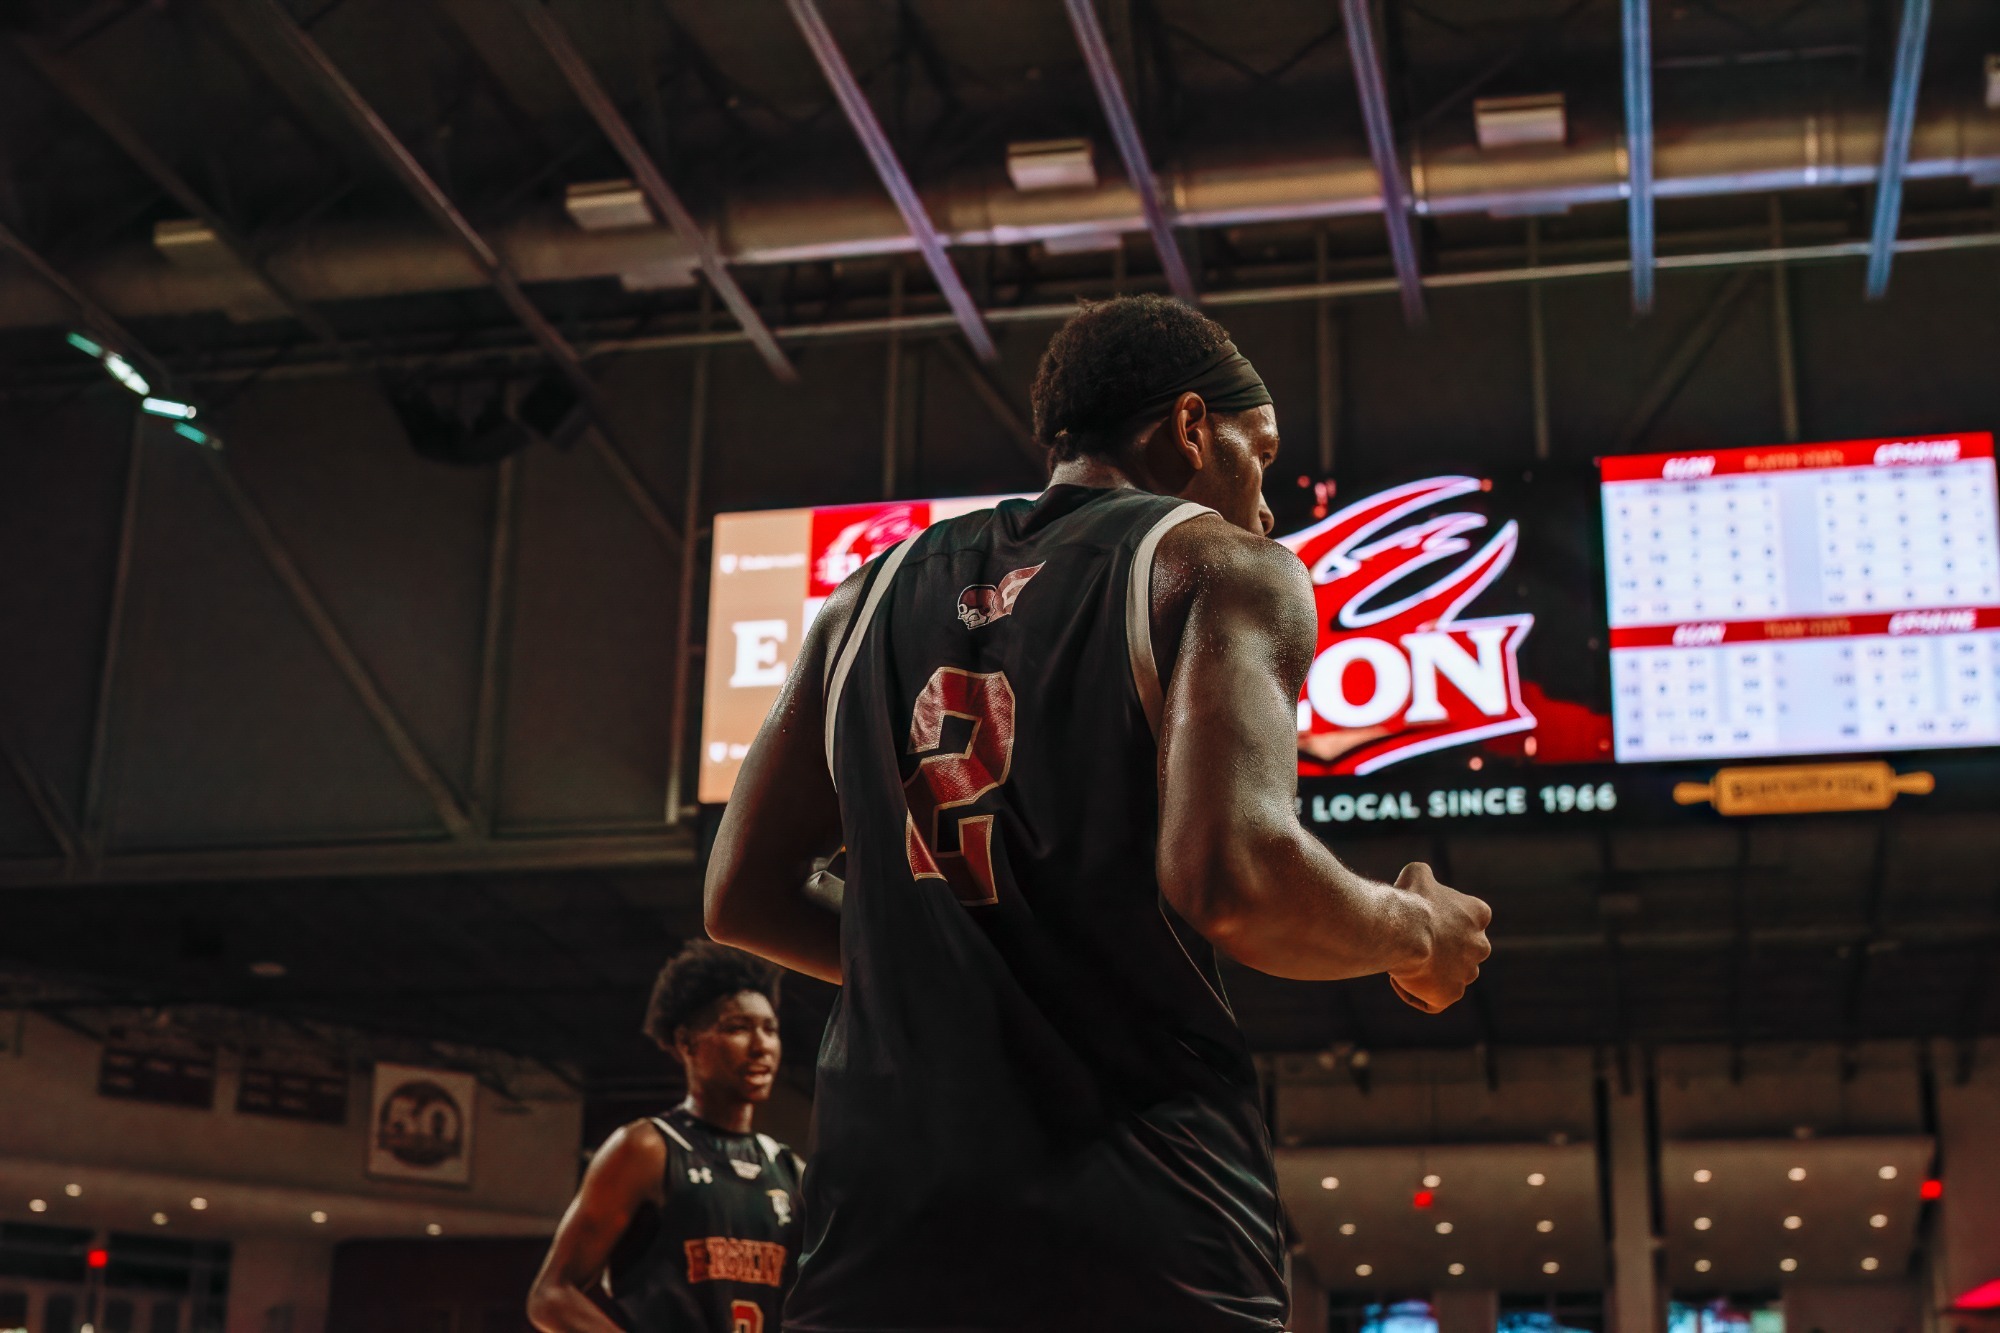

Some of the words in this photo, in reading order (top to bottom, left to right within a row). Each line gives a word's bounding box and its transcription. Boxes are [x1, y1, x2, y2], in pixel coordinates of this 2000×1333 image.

[1297, 627, 1508, 728] ON
[904, 666, 1016, 904] 2
[1312, 791, 1421, 822] LOCAL
[1428, 787, 1527, 817] SINCE
[1539, 782, 1617, 813] 1966
